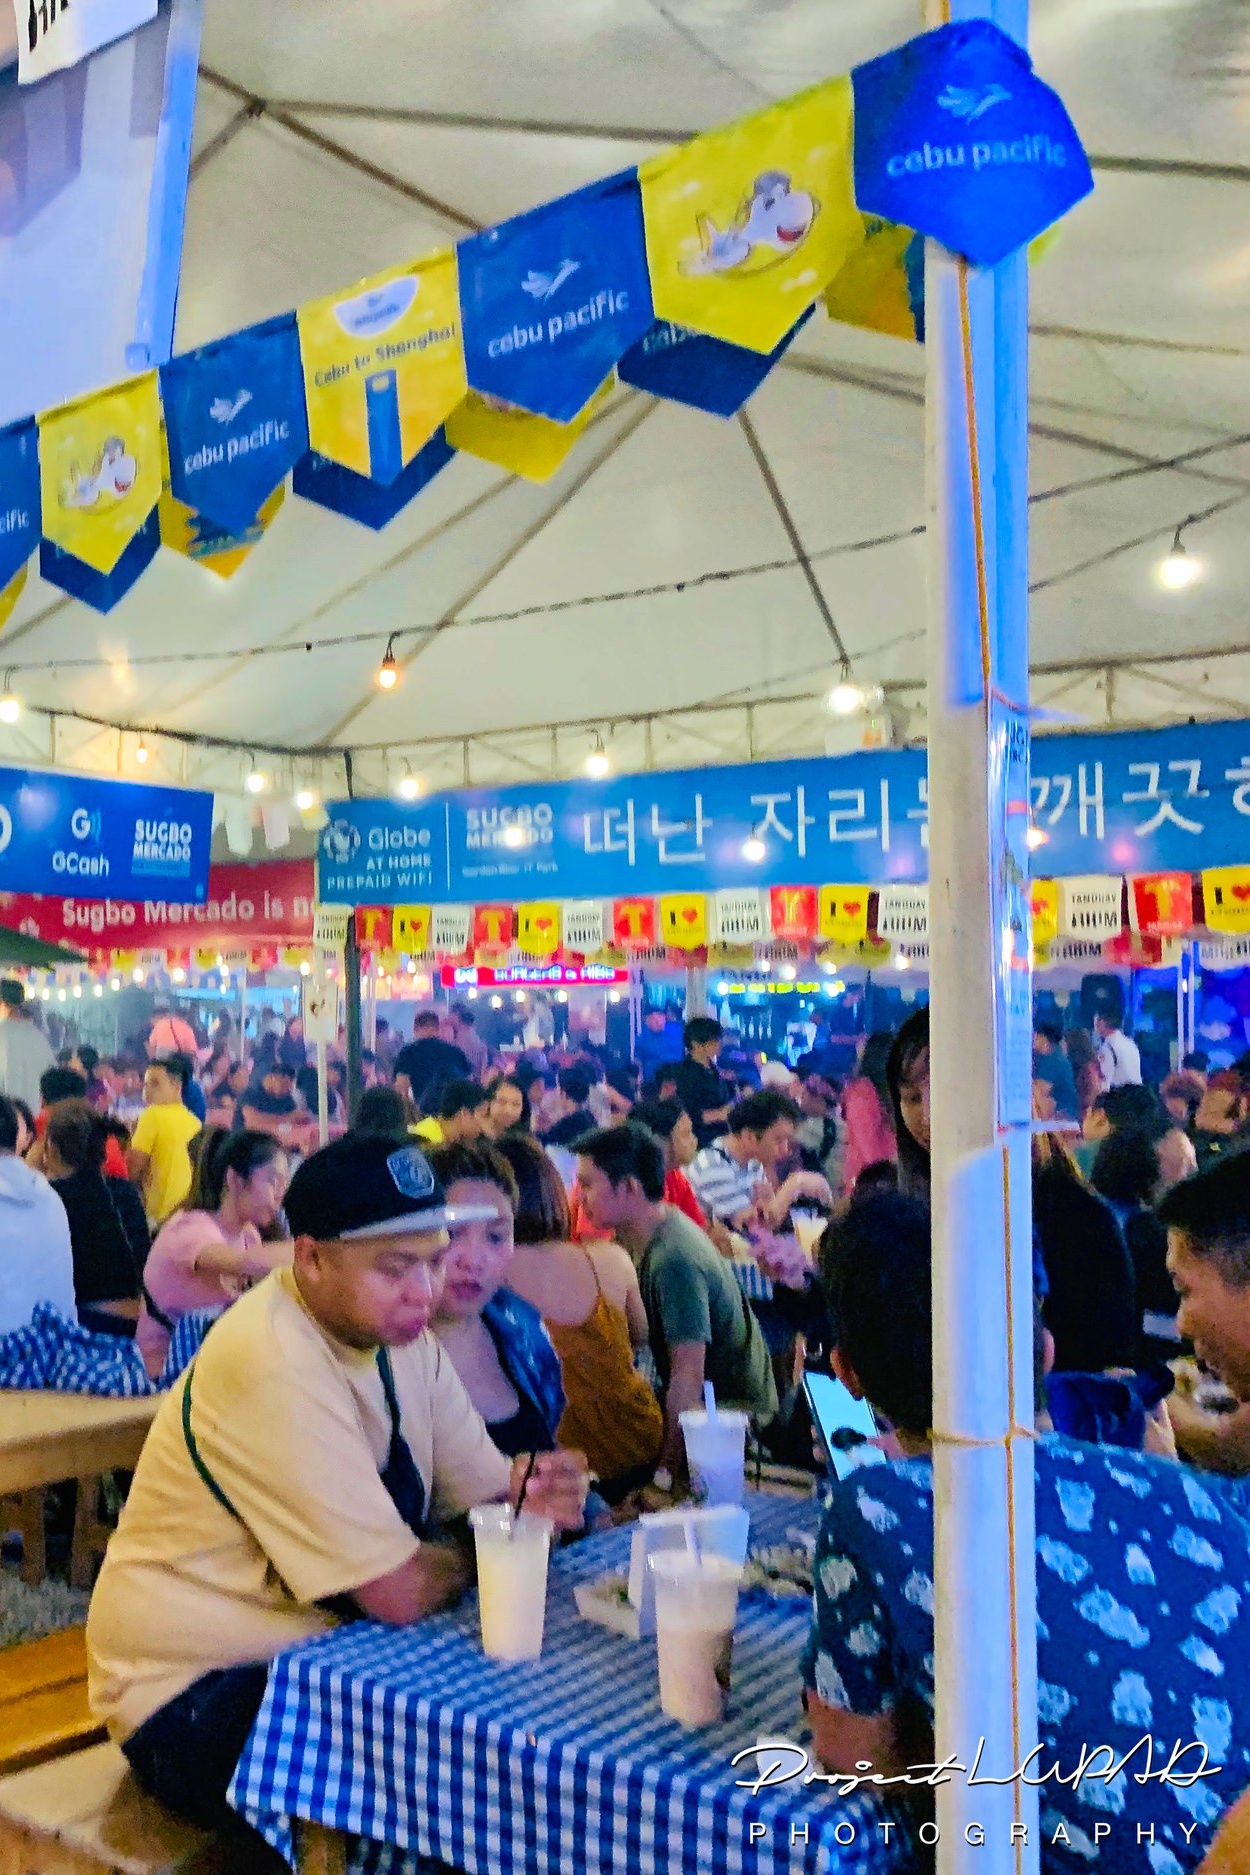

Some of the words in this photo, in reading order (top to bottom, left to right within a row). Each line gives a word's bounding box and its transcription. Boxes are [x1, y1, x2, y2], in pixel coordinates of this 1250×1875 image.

[886, 141, 964, 178] cebu
[972, 133, 1066, 171] pacific
[487, 320, 543, 359] cebu
[547, 289, 630, 343] pacific
[374, 325, 456, 361] Shanghai
[183, 443, 224, 477] cebu
[227, 419, 291, 464] pacific
[134, 818, 193, 845] SUGBO
[368, 825, 431, 850] Globe
[582, 793, 713, 867] 떠난
[52, 850, 110, 877] GCash
[132, 841, 192, 862] MERCADO
[366, 856, 383, 871] AT
[388, 852, 432, 869] HOME
[326, 873, 391, 891] PREPAID
[397, 871, 433, 887] WIFI
[62, 899, 136, 933] Sugbo
[144, 889, 255, 924] Mercado
